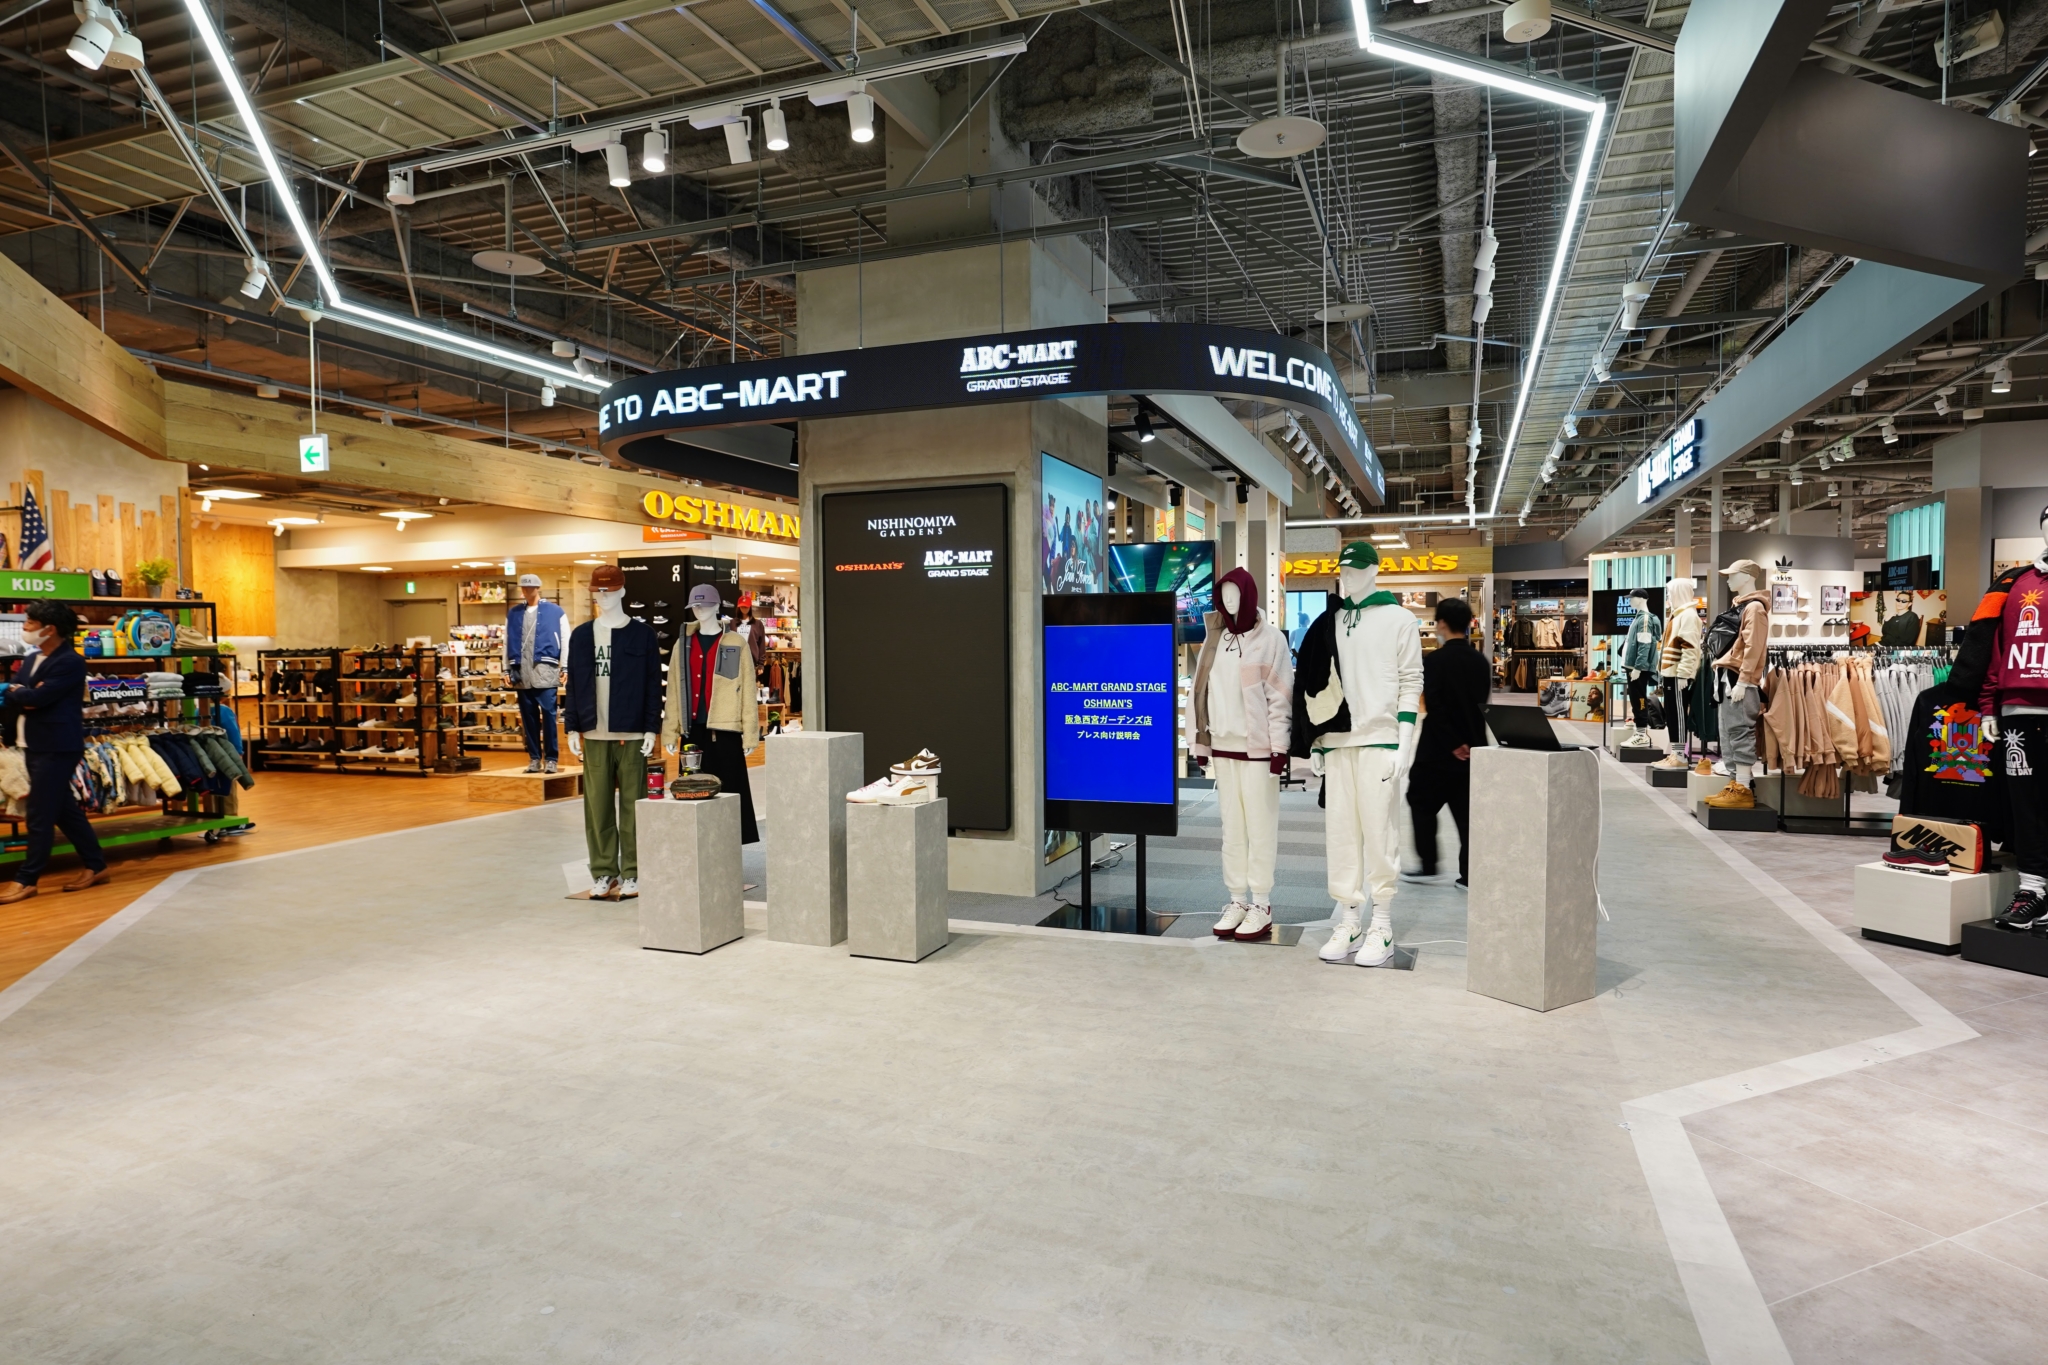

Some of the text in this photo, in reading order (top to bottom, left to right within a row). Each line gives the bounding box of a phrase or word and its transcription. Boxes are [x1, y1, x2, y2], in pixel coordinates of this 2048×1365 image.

[960, 340, 1077, 372] ABC-MART
[1208, 345, 1332, 402] WELCOME
[966, 373, 1071, 392] GRAND STAGE
[614, 394, 643, 424] TO
[651, 370, 847, 417] ABC-MART
[867, 515, 956, 530] NISHINOMIYA
[880, 527, 943, 538] GARDENS
[924, 550, 993, 566] ABC-MART
[1286, 551, 1459, 575] SHAN'S
[835, 562, 902, 572] OSHMAN'S
[928, 568, 990, 578] GRAND STAGE
[11, 577, 56, 592] KIDS
[1616, 595, 1632, 607] AB
[1051, 682, 1167, 692] ABC-MART GRAND STAGE
[93, 688, 144, 701] patagonia
[1084, 699, 1133, 709] OSHMAN'S
[1065, 714, 1153, 726] 阪急西宮ガーデンズ店
[1077, 730, 1141, 740] プレス向け説明会
[675, 790, 710, 799] patagonia
[1899, 823, 1967, 858] NIKE
